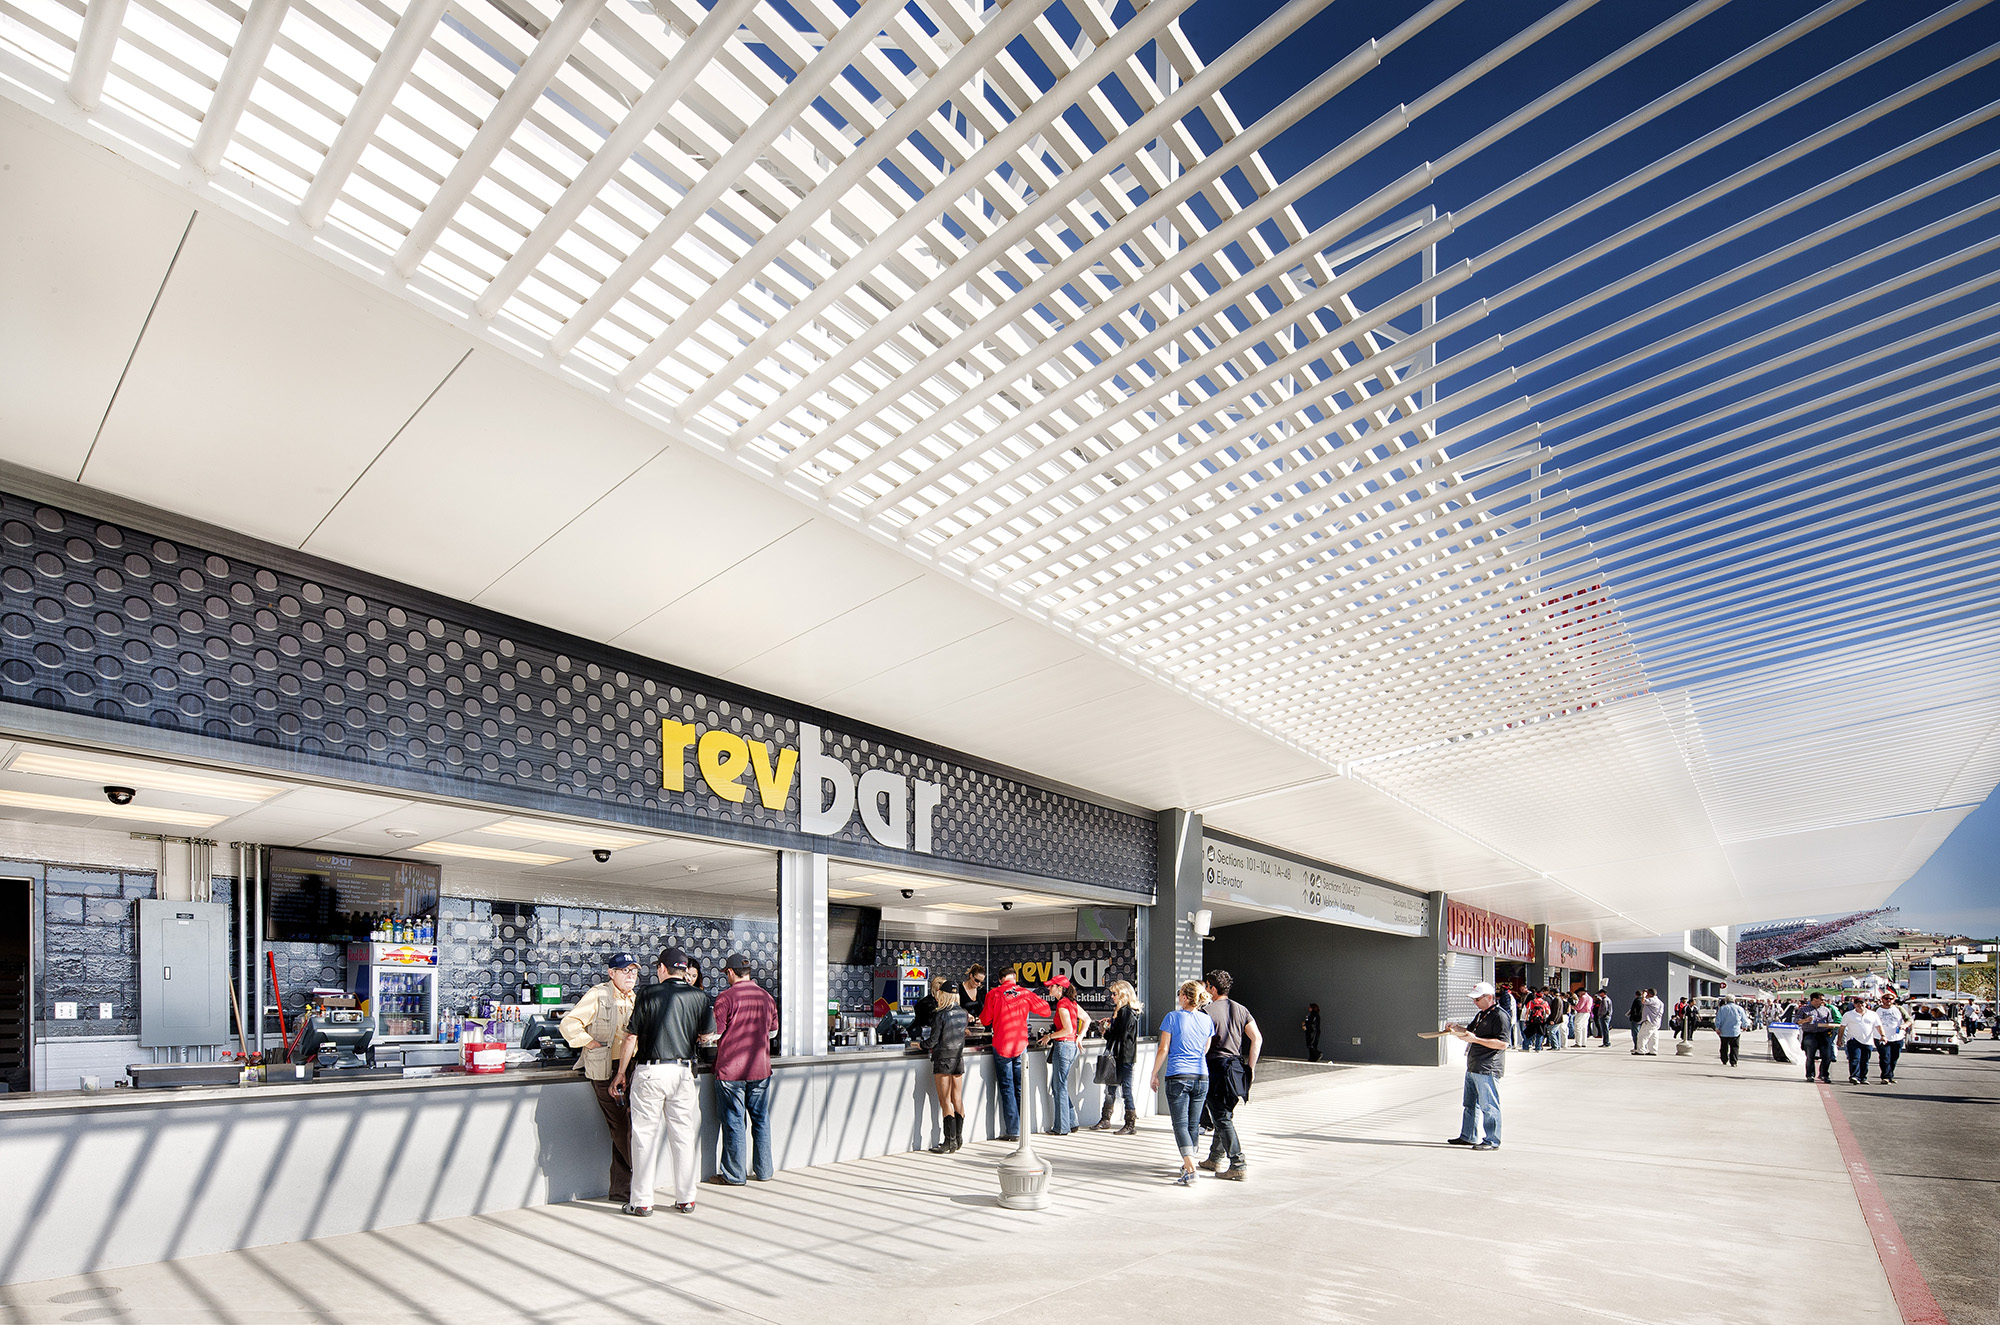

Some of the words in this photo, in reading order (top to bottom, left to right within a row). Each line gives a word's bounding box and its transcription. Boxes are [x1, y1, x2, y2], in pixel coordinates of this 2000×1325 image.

[662, 718, 941, 854] revbar
[1217, 849, 1244, 869] Sections
[1216, 869, 1244, 889] Elevator
[1322, 877, 1341, 892] Sections
[1448, 906, 1493, 954] URRITO
[348, 948, 358, 961] Red
[874, 970, 886, 978] Red
[886, 970, 897, 978] Bull
[1013, 951, 1110, 987] revbar
